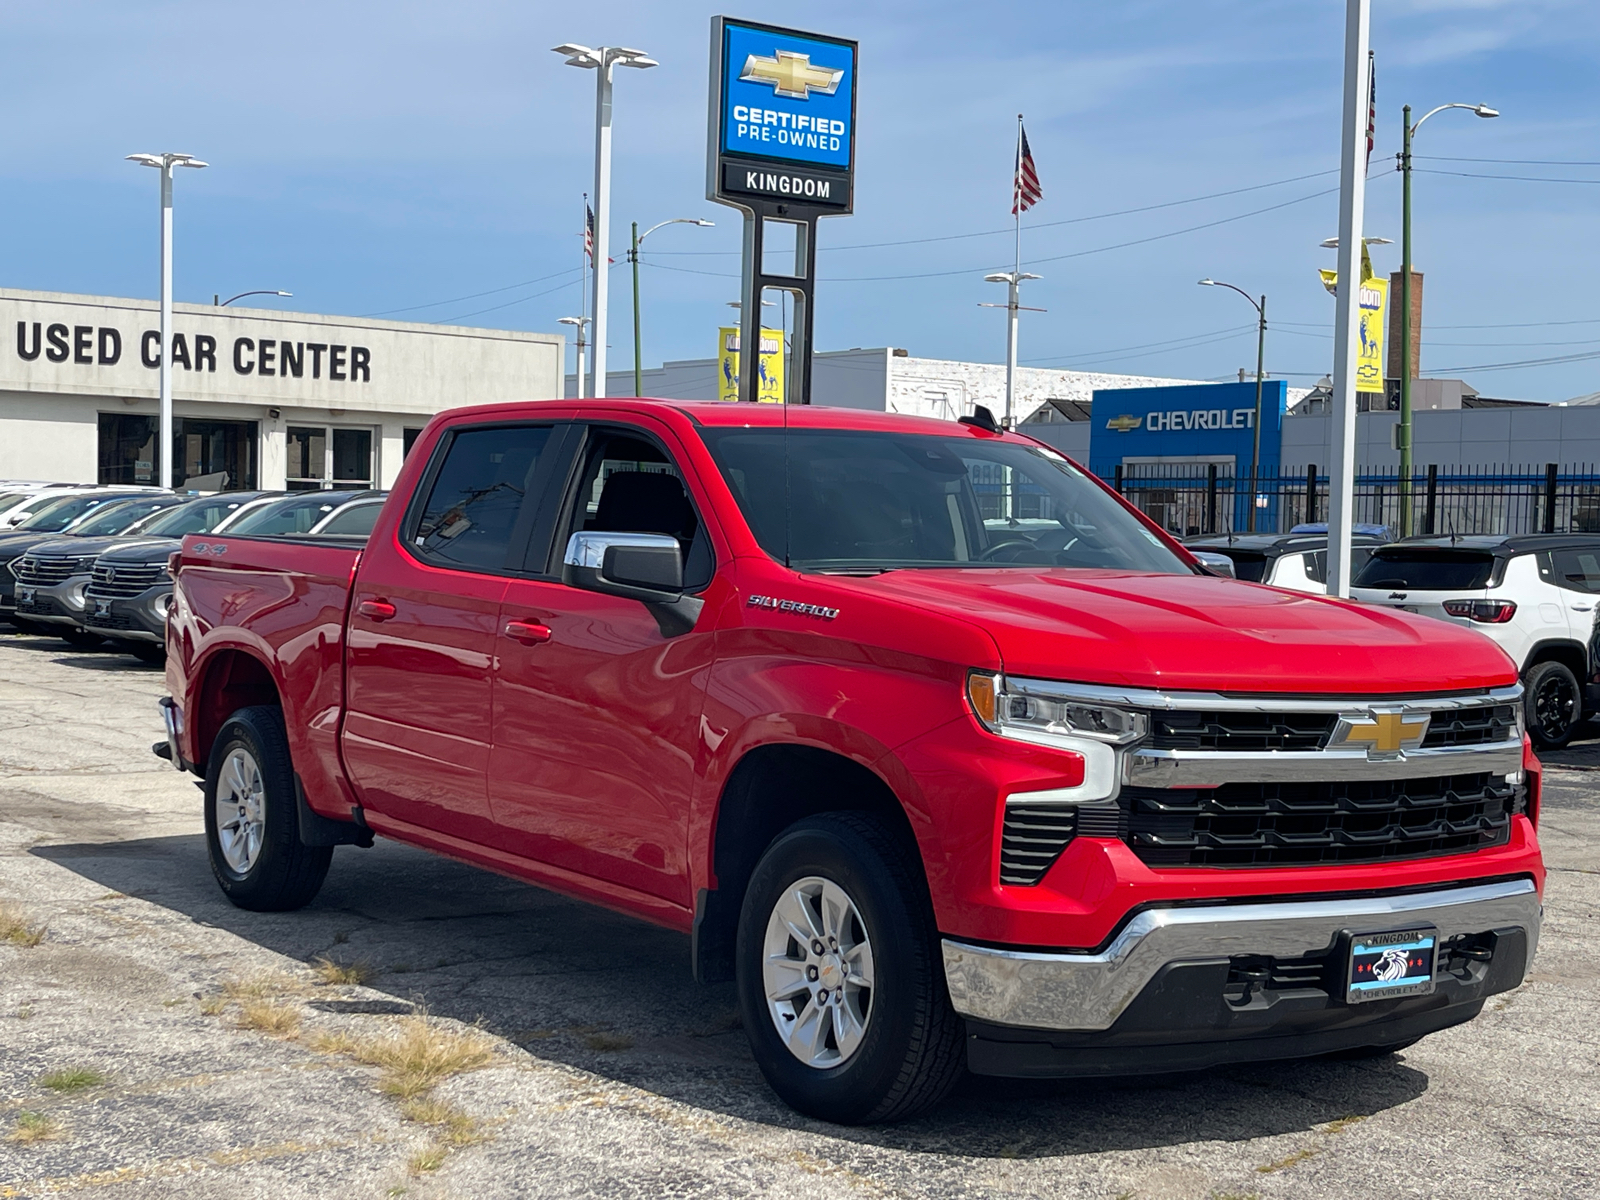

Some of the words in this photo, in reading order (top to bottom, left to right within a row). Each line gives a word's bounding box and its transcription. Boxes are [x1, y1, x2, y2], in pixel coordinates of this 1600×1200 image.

[733, 105, 845, 136] CERTIFIED
[737, 123, 840, 151] PRE-OWNED
[746, 171, 830, 198] KINGDOM
[17, 321, 122, 366] USED
[141, 329, 217, 373] CAR
[233, 336, 371, 383] CENTER
[1146, 408, 1257, 431] CHEVROLET
[747, 594, 840, 618] SILVERADO
[1371, 931, 1419, 945] KINGDOM
[1366, 985, 1414, 998] CHEVROLET
